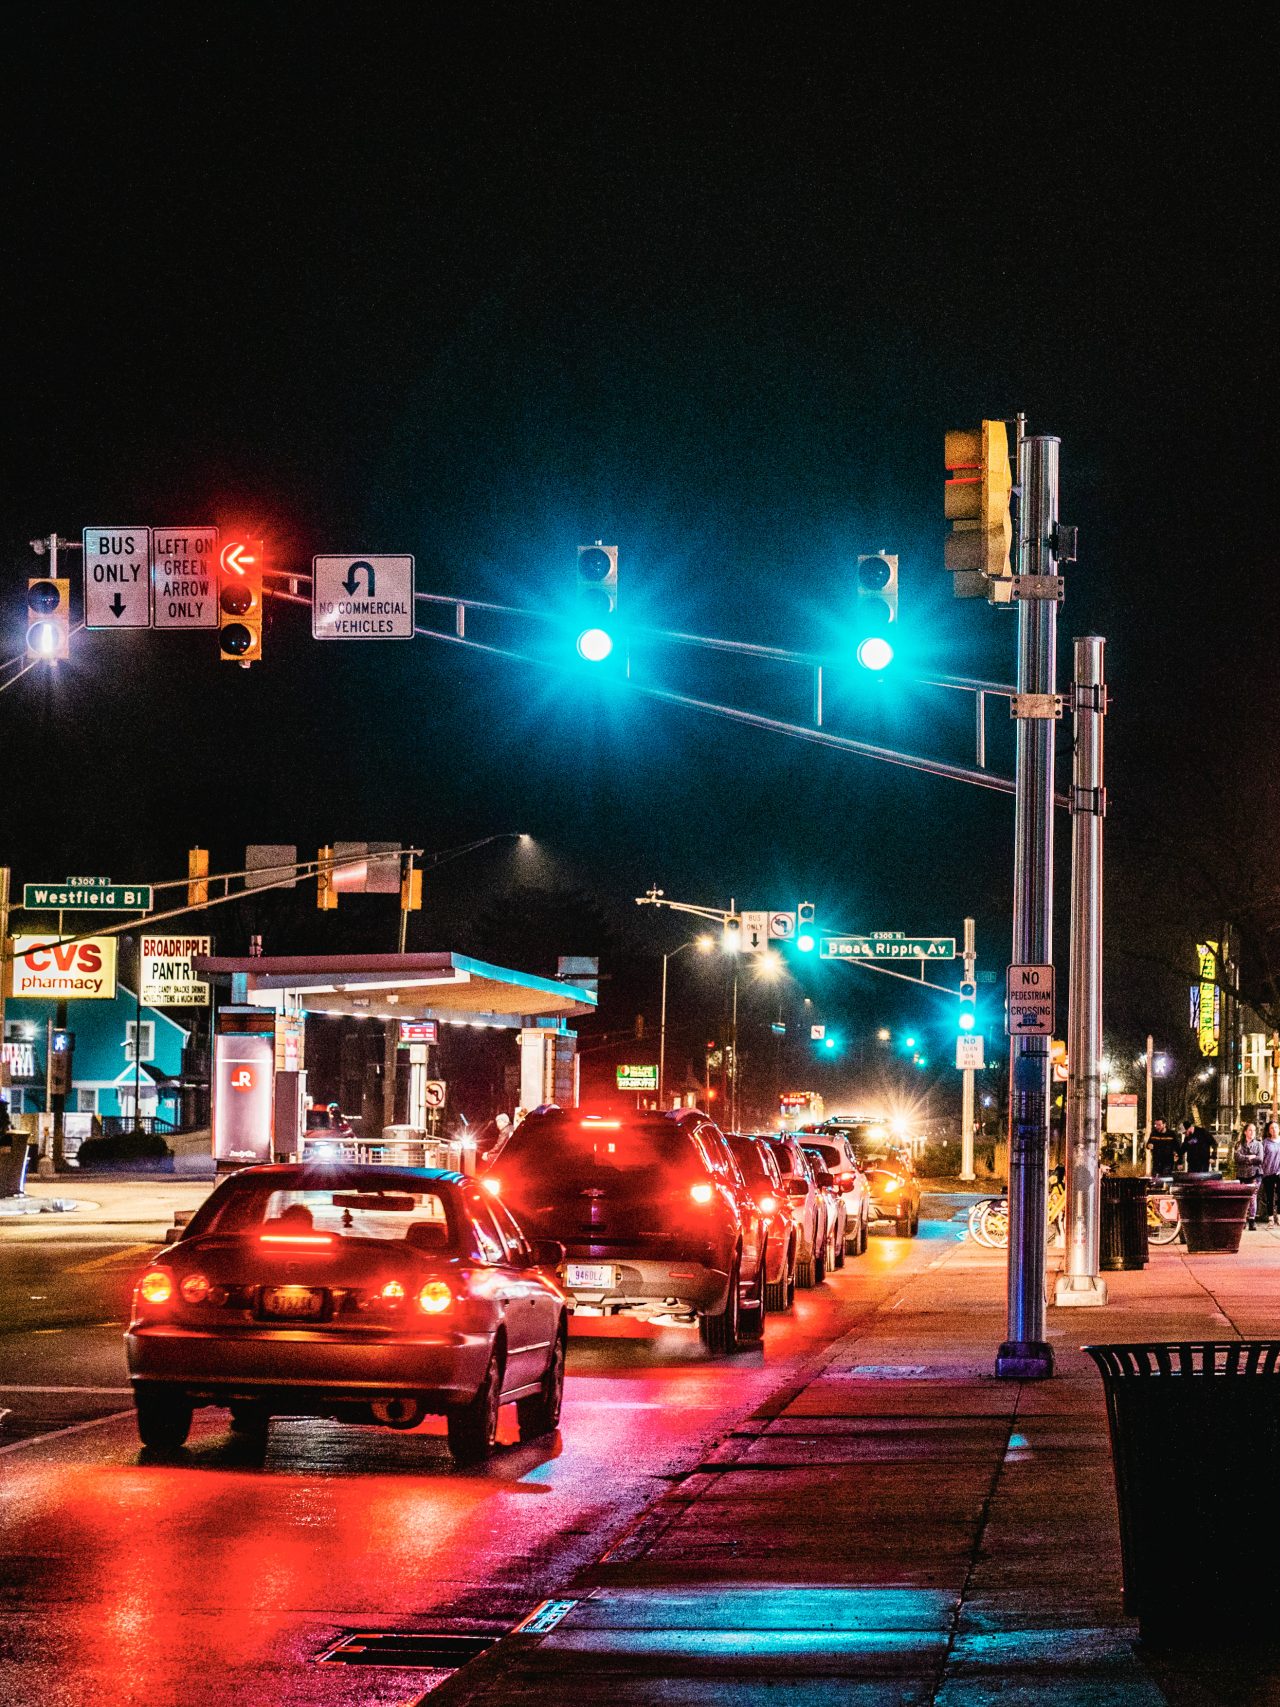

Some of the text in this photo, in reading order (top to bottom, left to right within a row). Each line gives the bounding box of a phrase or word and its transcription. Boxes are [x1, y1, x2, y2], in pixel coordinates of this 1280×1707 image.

[99, 536, 135, 555] BUS
[157, 538, 213, 555] LEFT ON
[93, 564, 141, 583] ONLY
[164, 560, 207, 576] GREEN
[163, 581, 209, 597] ARROW
[168, 602, 203, 618] ONLY
[319, 601, 408, 615] NO COMMERCIAL
[335, 620, 394, 633] VEHICLES
[70, 878, 106, 886] 6300 N
[34, 889, 142, 905] Westfield Bl
[748, 914, 761, 922] BUS
[746, 923, 763, 931] ONLY
[143, 939, 208, 957] BROADRIPPLE
[828, 943, 869, 954] Broad
[876, 943, 921, 955] Ripple
[24, 942, 103, 973] CVS
[21, 974, 103, 993] pharmacy
[1022, 971, 1039, 985] NO
[1010, 991, 1051, 1000] PEDESTRIAN
[1010, 1006, 1051, 1016] CROSSING
